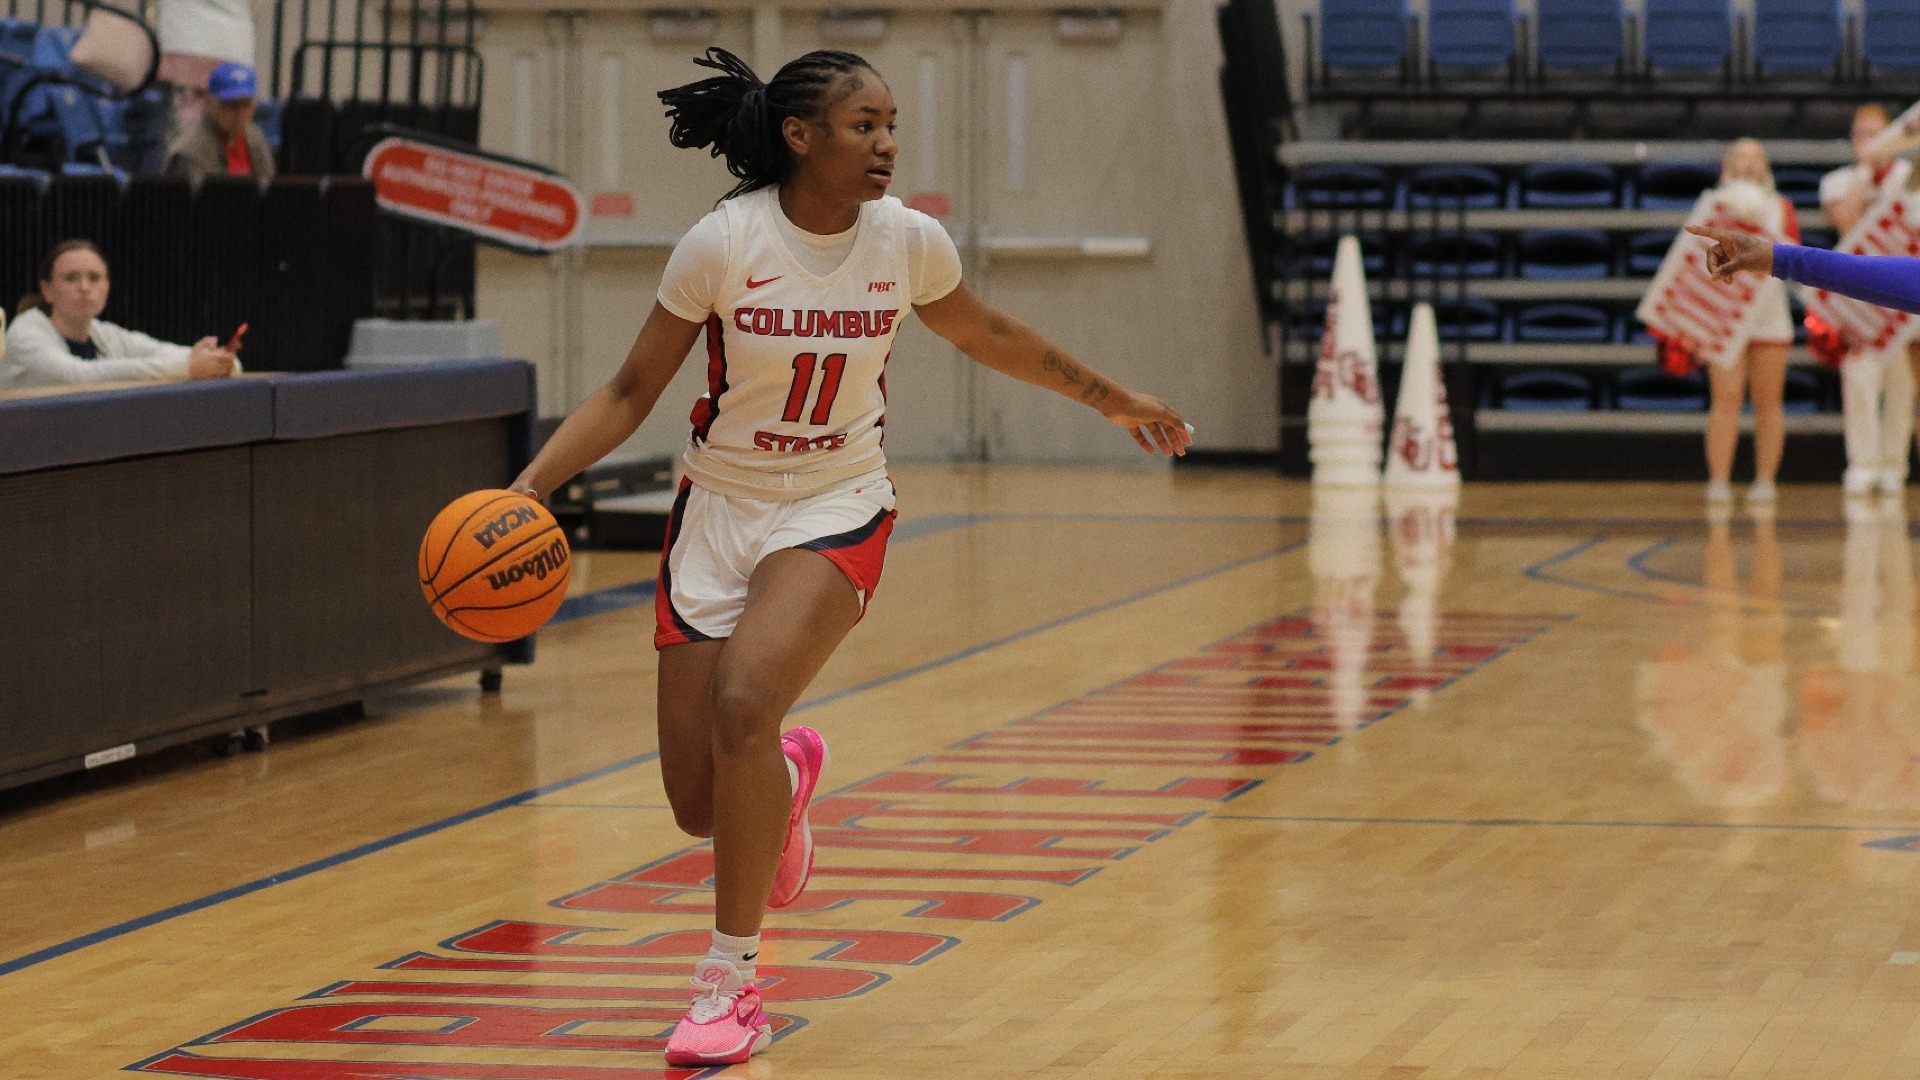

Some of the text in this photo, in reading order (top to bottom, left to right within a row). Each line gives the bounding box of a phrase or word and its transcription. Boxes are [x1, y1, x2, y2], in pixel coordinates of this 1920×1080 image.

[867, 281, 896, 292] PBC
[734, 307, 899, 338] COLUMBUS
[781, 352, 847, 425] 11
[753, 431, 848, 452] STATE
[473, 505, 540, 550] NCAA
[486, 537, 568, 590] Wilson
